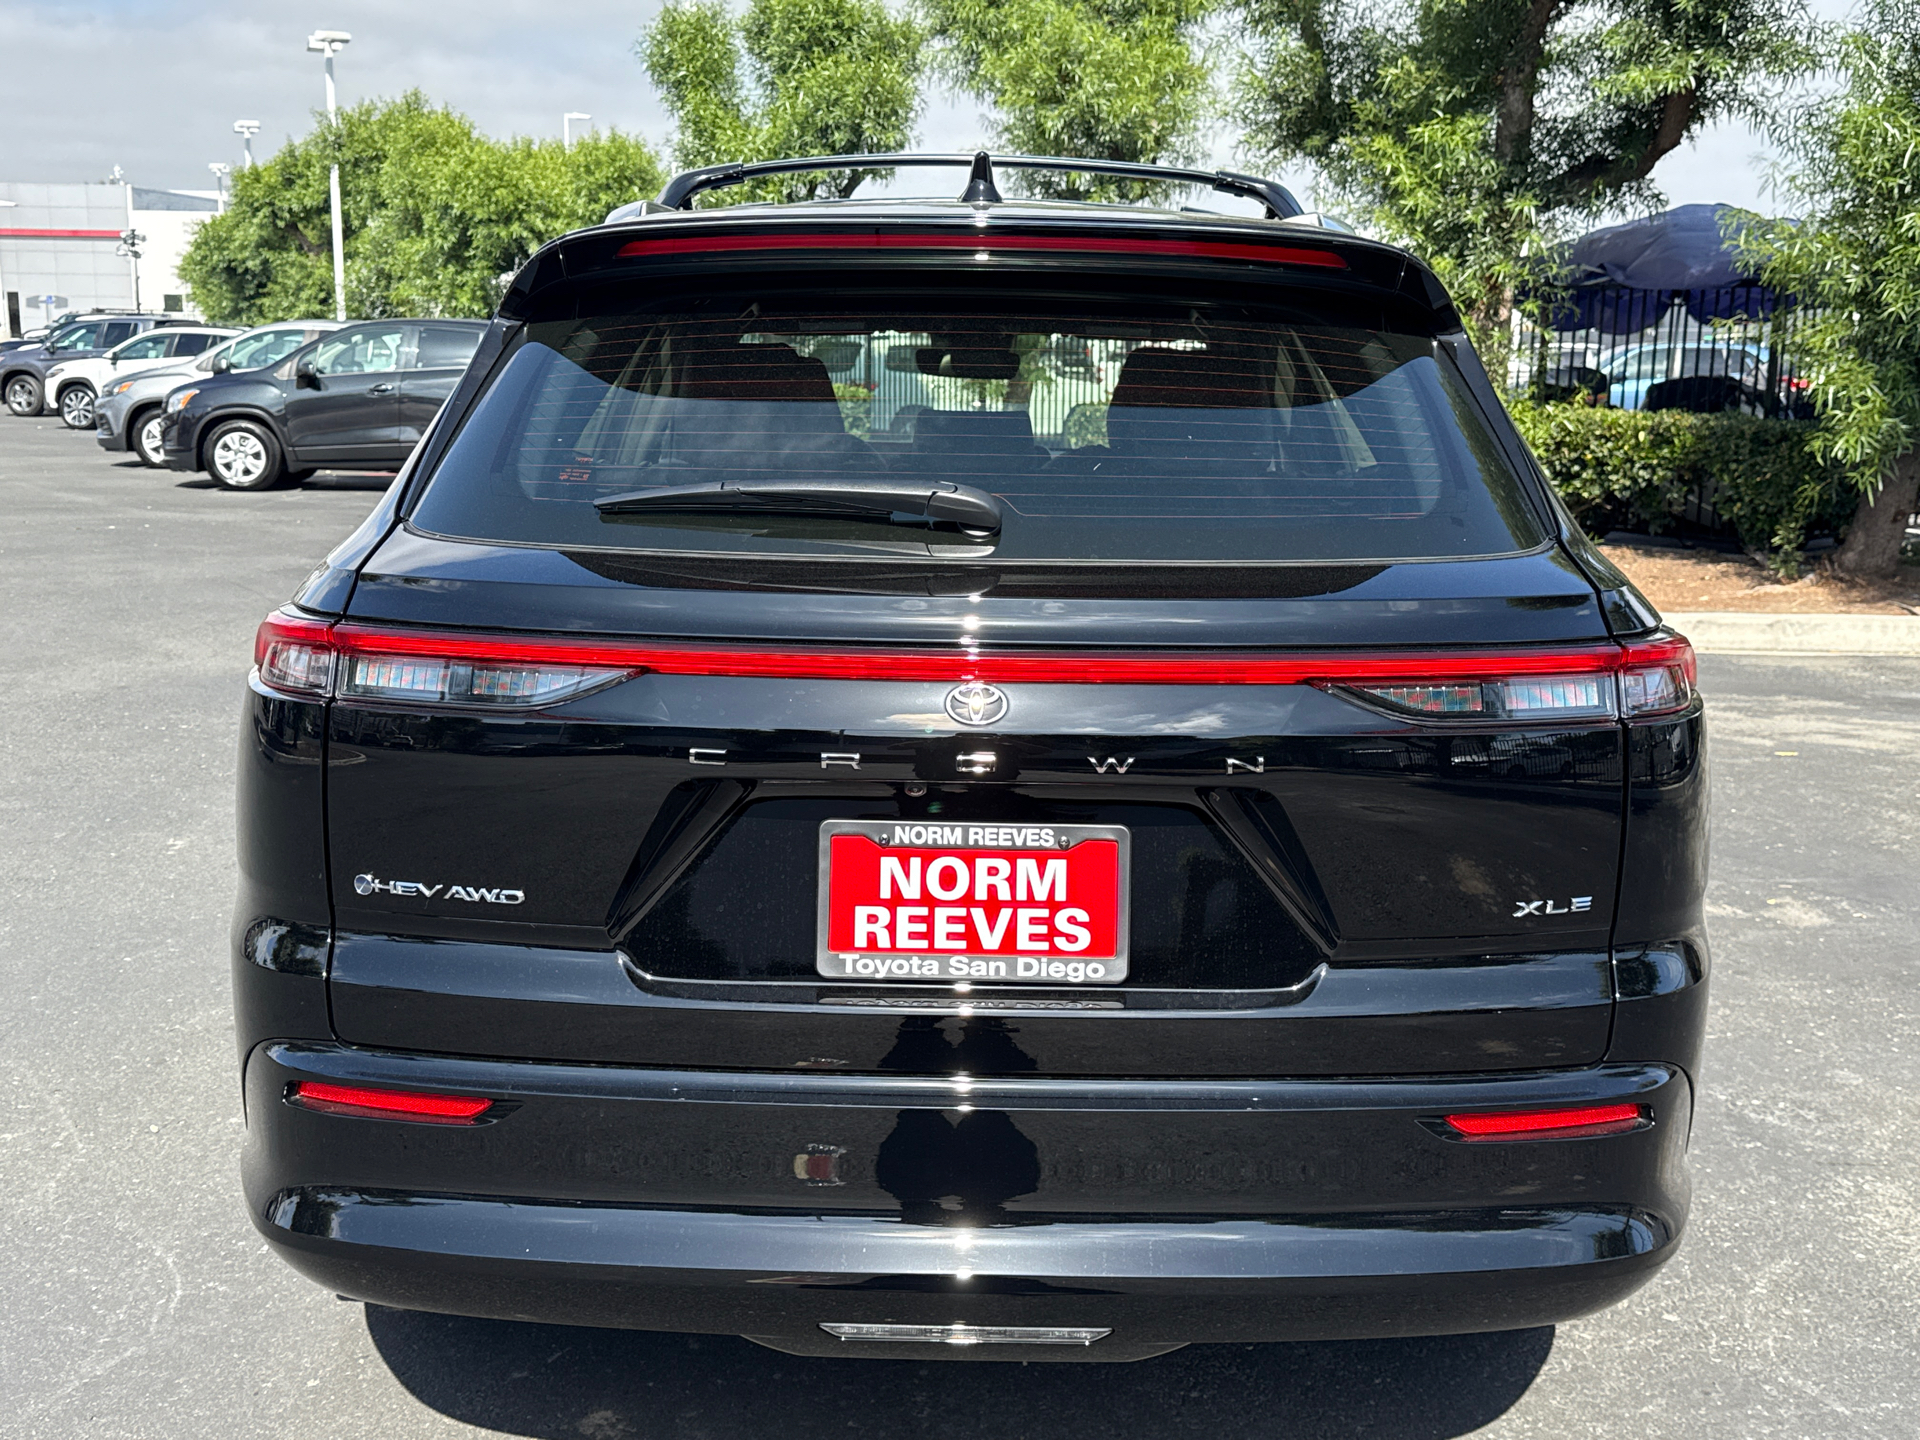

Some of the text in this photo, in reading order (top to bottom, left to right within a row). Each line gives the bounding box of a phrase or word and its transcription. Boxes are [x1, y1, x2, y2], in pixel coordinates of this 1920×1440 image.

[688, 747, 1265, 775] CROWN
[894, 826, 1055, 847] NORM REEVES
[374, 878, 526, 905] HEV AWD
[879, 856, 1068, 902] NORM
[1512, 896, 1593, 918] XLE
[853, 905, 1092, 951] REEVES
[838, 954, 1106, 983] Toyota San Diego
